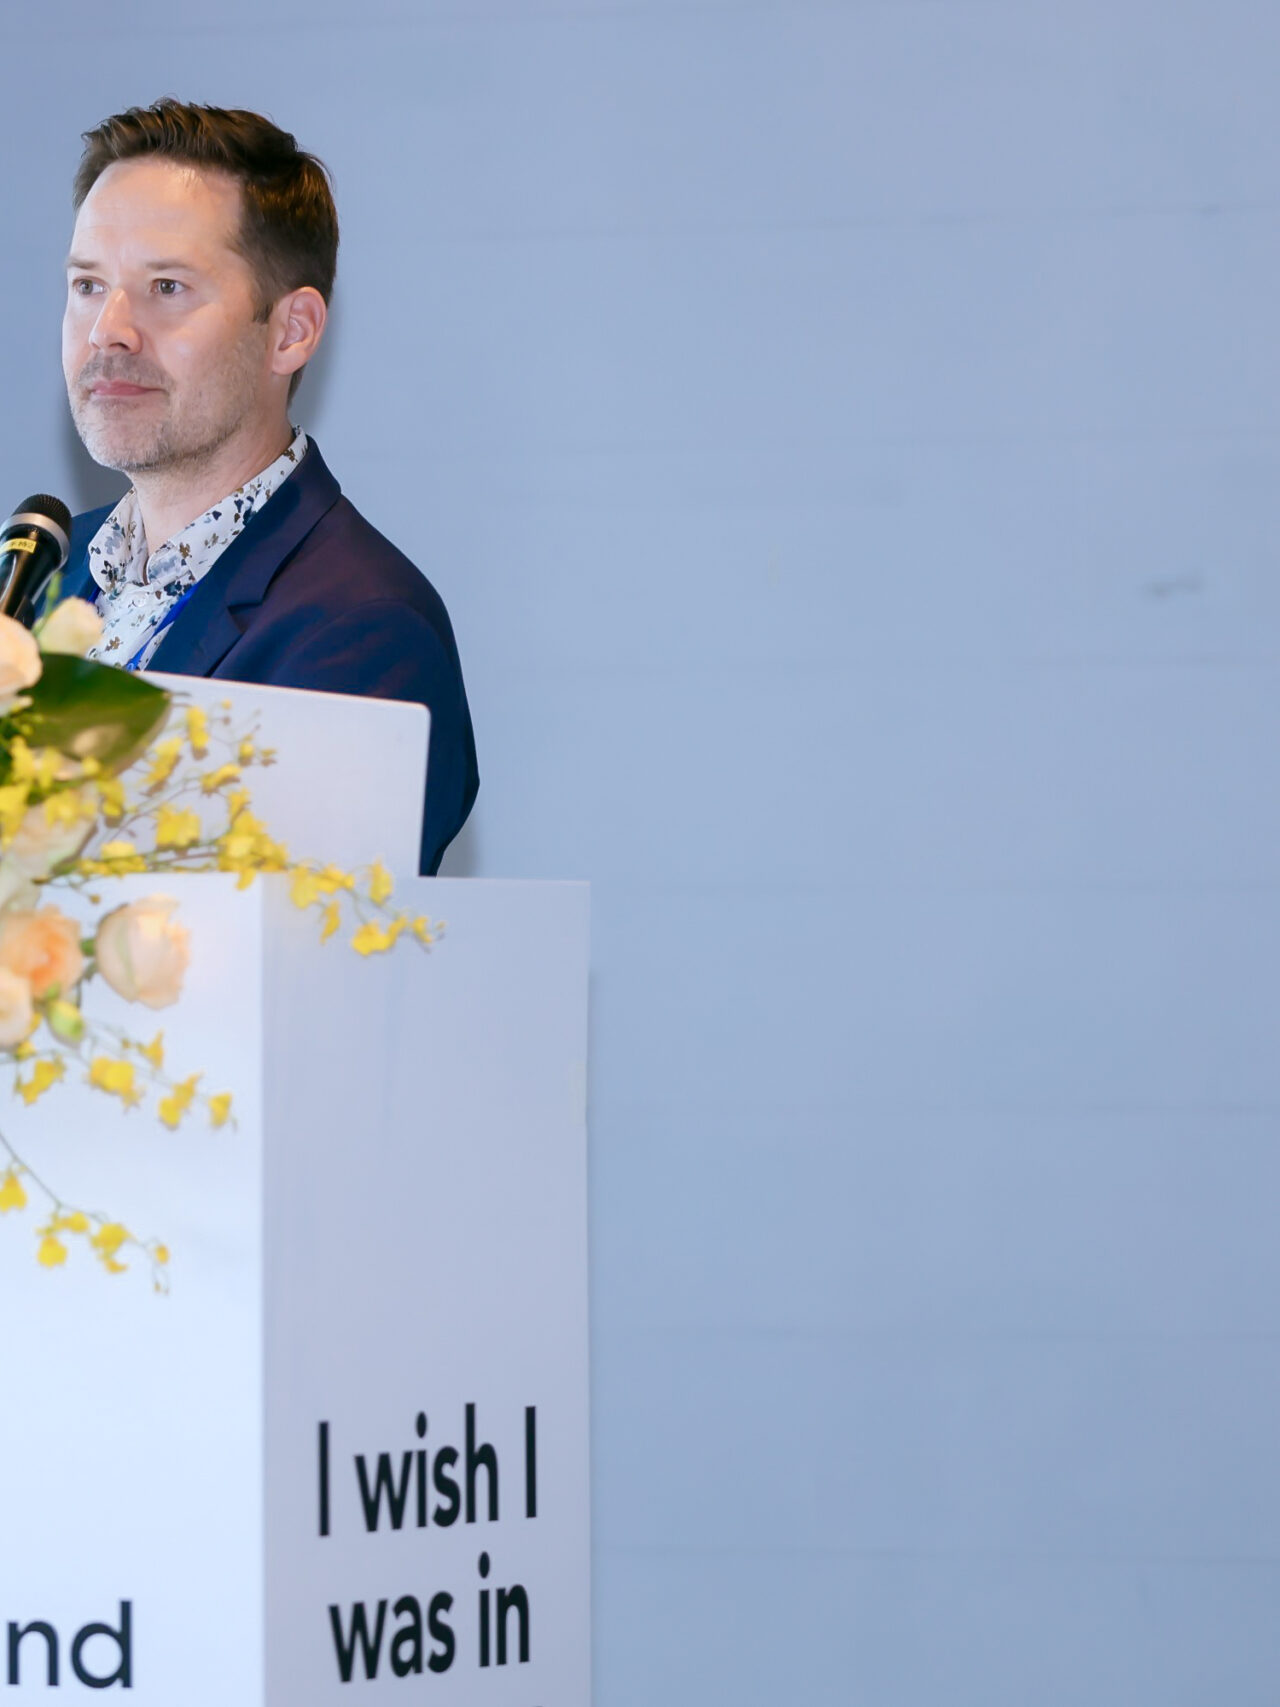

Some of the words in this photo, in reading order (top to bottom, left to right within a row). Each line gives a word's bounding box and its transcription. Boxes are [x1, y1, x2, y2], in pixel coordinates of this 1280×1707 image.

[318, 1420, 331, 1538] I
[354, 1402, 499, 1533] wish
[524, 1405, 537, 1519] I
[328, 1590, 456, 1684] was
[478, 1551, 530, 1668] in
